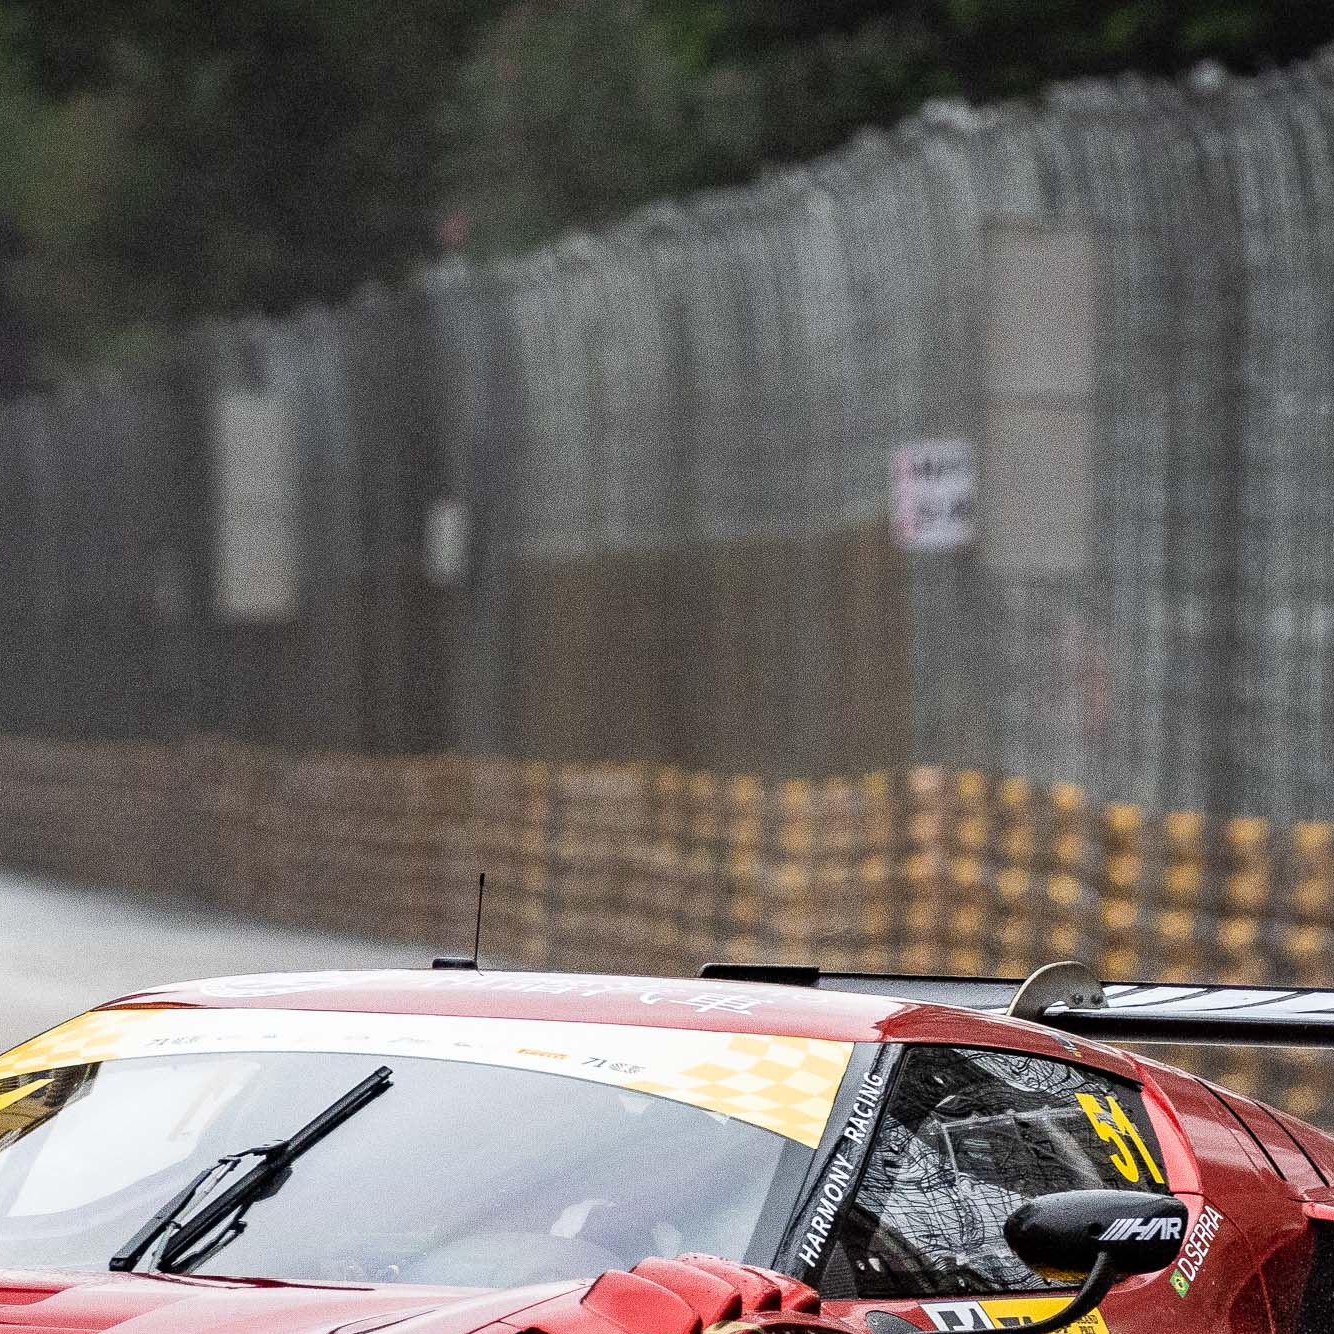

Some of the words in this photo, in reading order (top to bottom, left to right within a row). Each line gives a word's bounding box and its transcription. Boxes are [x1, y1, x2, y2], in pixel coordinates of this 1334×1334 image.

[799, 1154, 855, 1268] HARMONY
[844, 1072, 883, 1145] RACING
[1074, 1093, 1165, 1184] 51
[1177, 1205, 1224, 1281] D.SERRA
